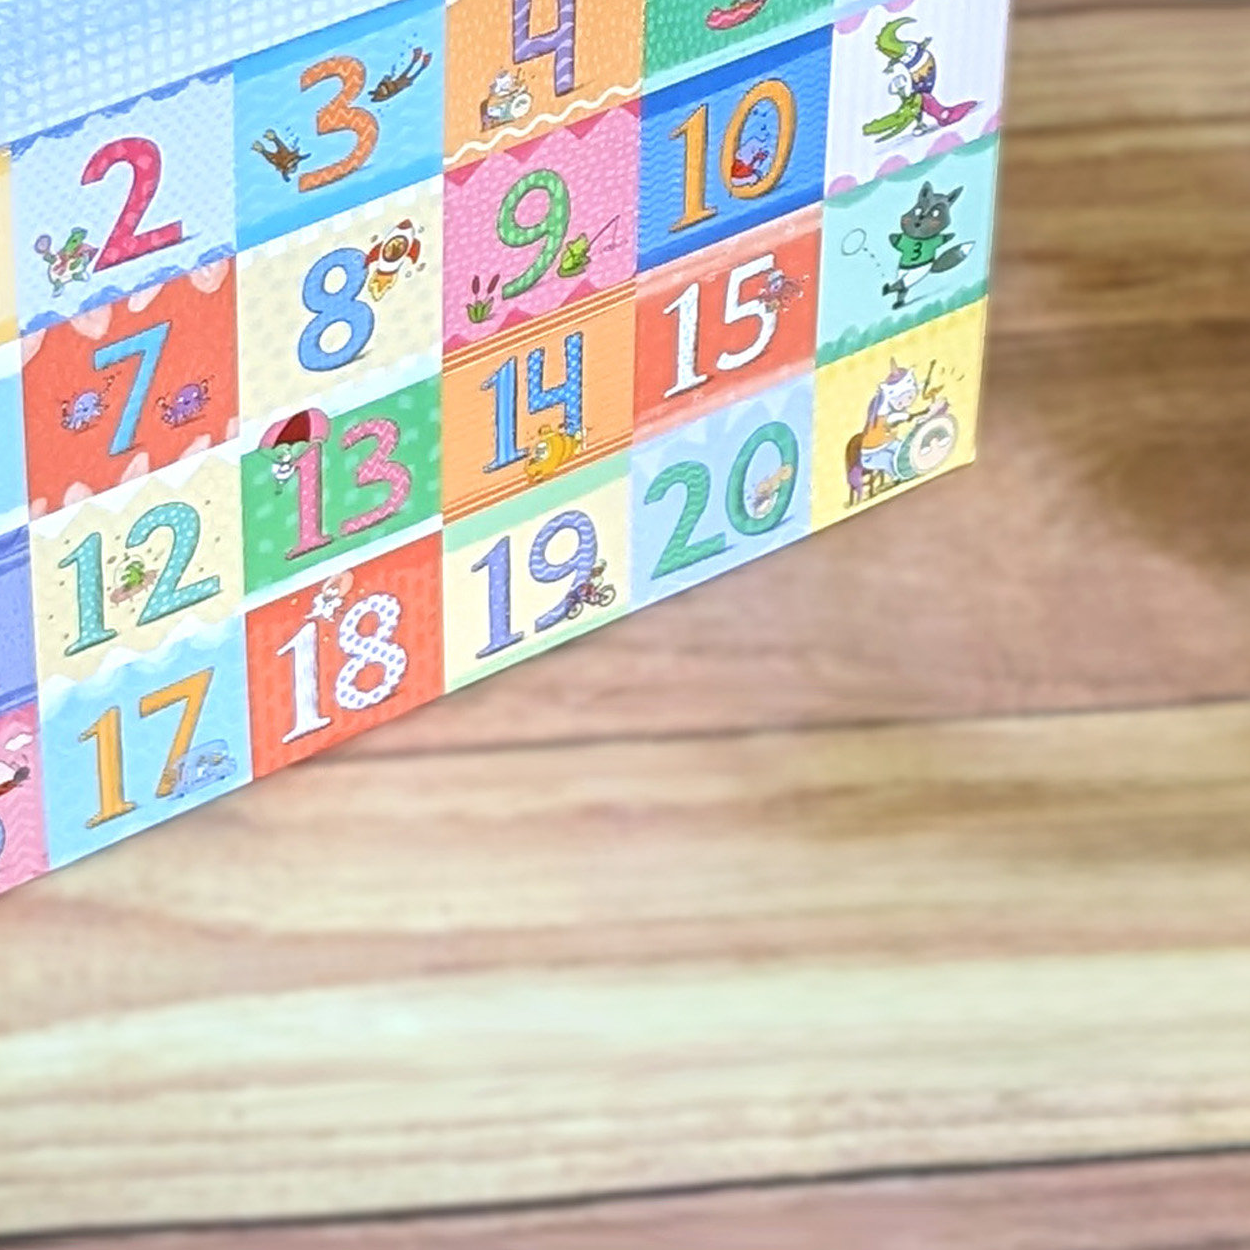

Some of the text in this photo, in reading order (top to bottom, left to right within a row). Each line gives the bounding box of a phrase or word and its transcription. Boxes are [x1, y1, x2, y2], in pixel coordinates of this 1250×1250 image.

[298, 55, 379, 192] 3
[670, 78, 796, 233] 10
[80, 137, 183, 272] 2
[497, 169, 571, 300] 9
[911, 242, 922, 261] 3
[297, 248, 375, 372] 8
[664, 253, 777, 398] 15
[94, 320, 171, 455] 7
[481, 331, 583, 473] 14
[286, 417, 411, 560] 13
[645, 421, 799, 580] 20
[58, 502, 220, 656] 12
[471, 509, 598, 659] 19
[276, 593, 408, 743] 18
[79, 668, 214, 829] 17
